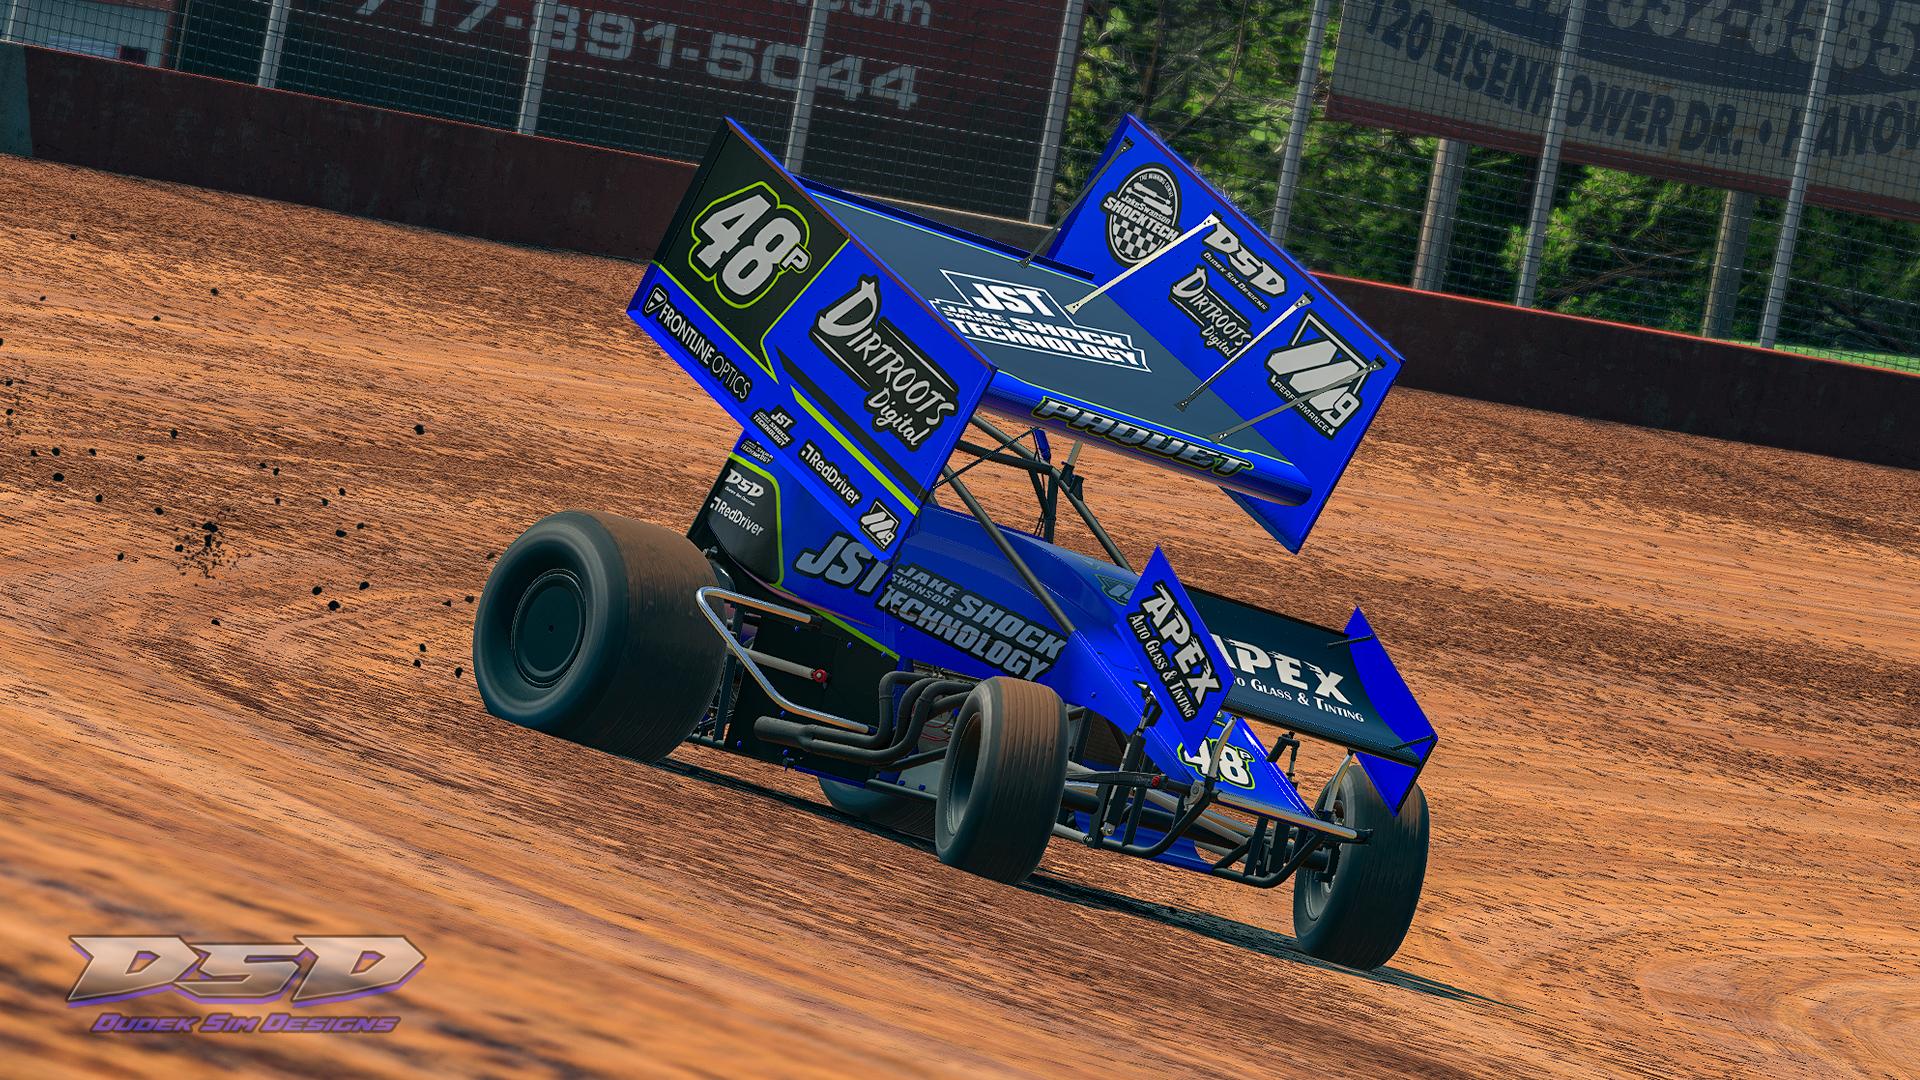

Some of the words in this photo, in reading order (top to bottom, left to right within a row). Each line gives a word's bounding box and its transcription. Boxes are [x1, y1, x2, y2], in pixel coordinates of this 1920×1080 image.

[1679, 99, 1742, 155] DR.
[1103, 196, 1180, 242] SHOCKTECH
[1203, 221, 1286, 295] DSD
[970, 282, 1056, 317] JST
[658, 303, 716, 365] FRONTLINE
[711, 355, 751, 400] OPTICS
[947, 317, 1140, 366] TECHNOLOGY
[1009, 316, 1132, 350] SHOCK
[1201, 324, 1238, 358] Digital
[770, 412, 794, 429] JST
[866, 386, 931, 448] Digital
[724, 468, 765, 498] DSD
[808, 451, 861, 504] RedDriver
[717, 501, 765, 536] RedDriver
[891, 573, 950, 607] SWANSON
[897, 565, 961, 599] JAKE
[877, 584, 1051, 682] TECHNOLOGY
[952, 594, 1068, 660] SHOCK
[1142, 583, 1221, 705] APEX
[1162, 669, 1178, 682] &
[1297, 691, 1310, 706] &
